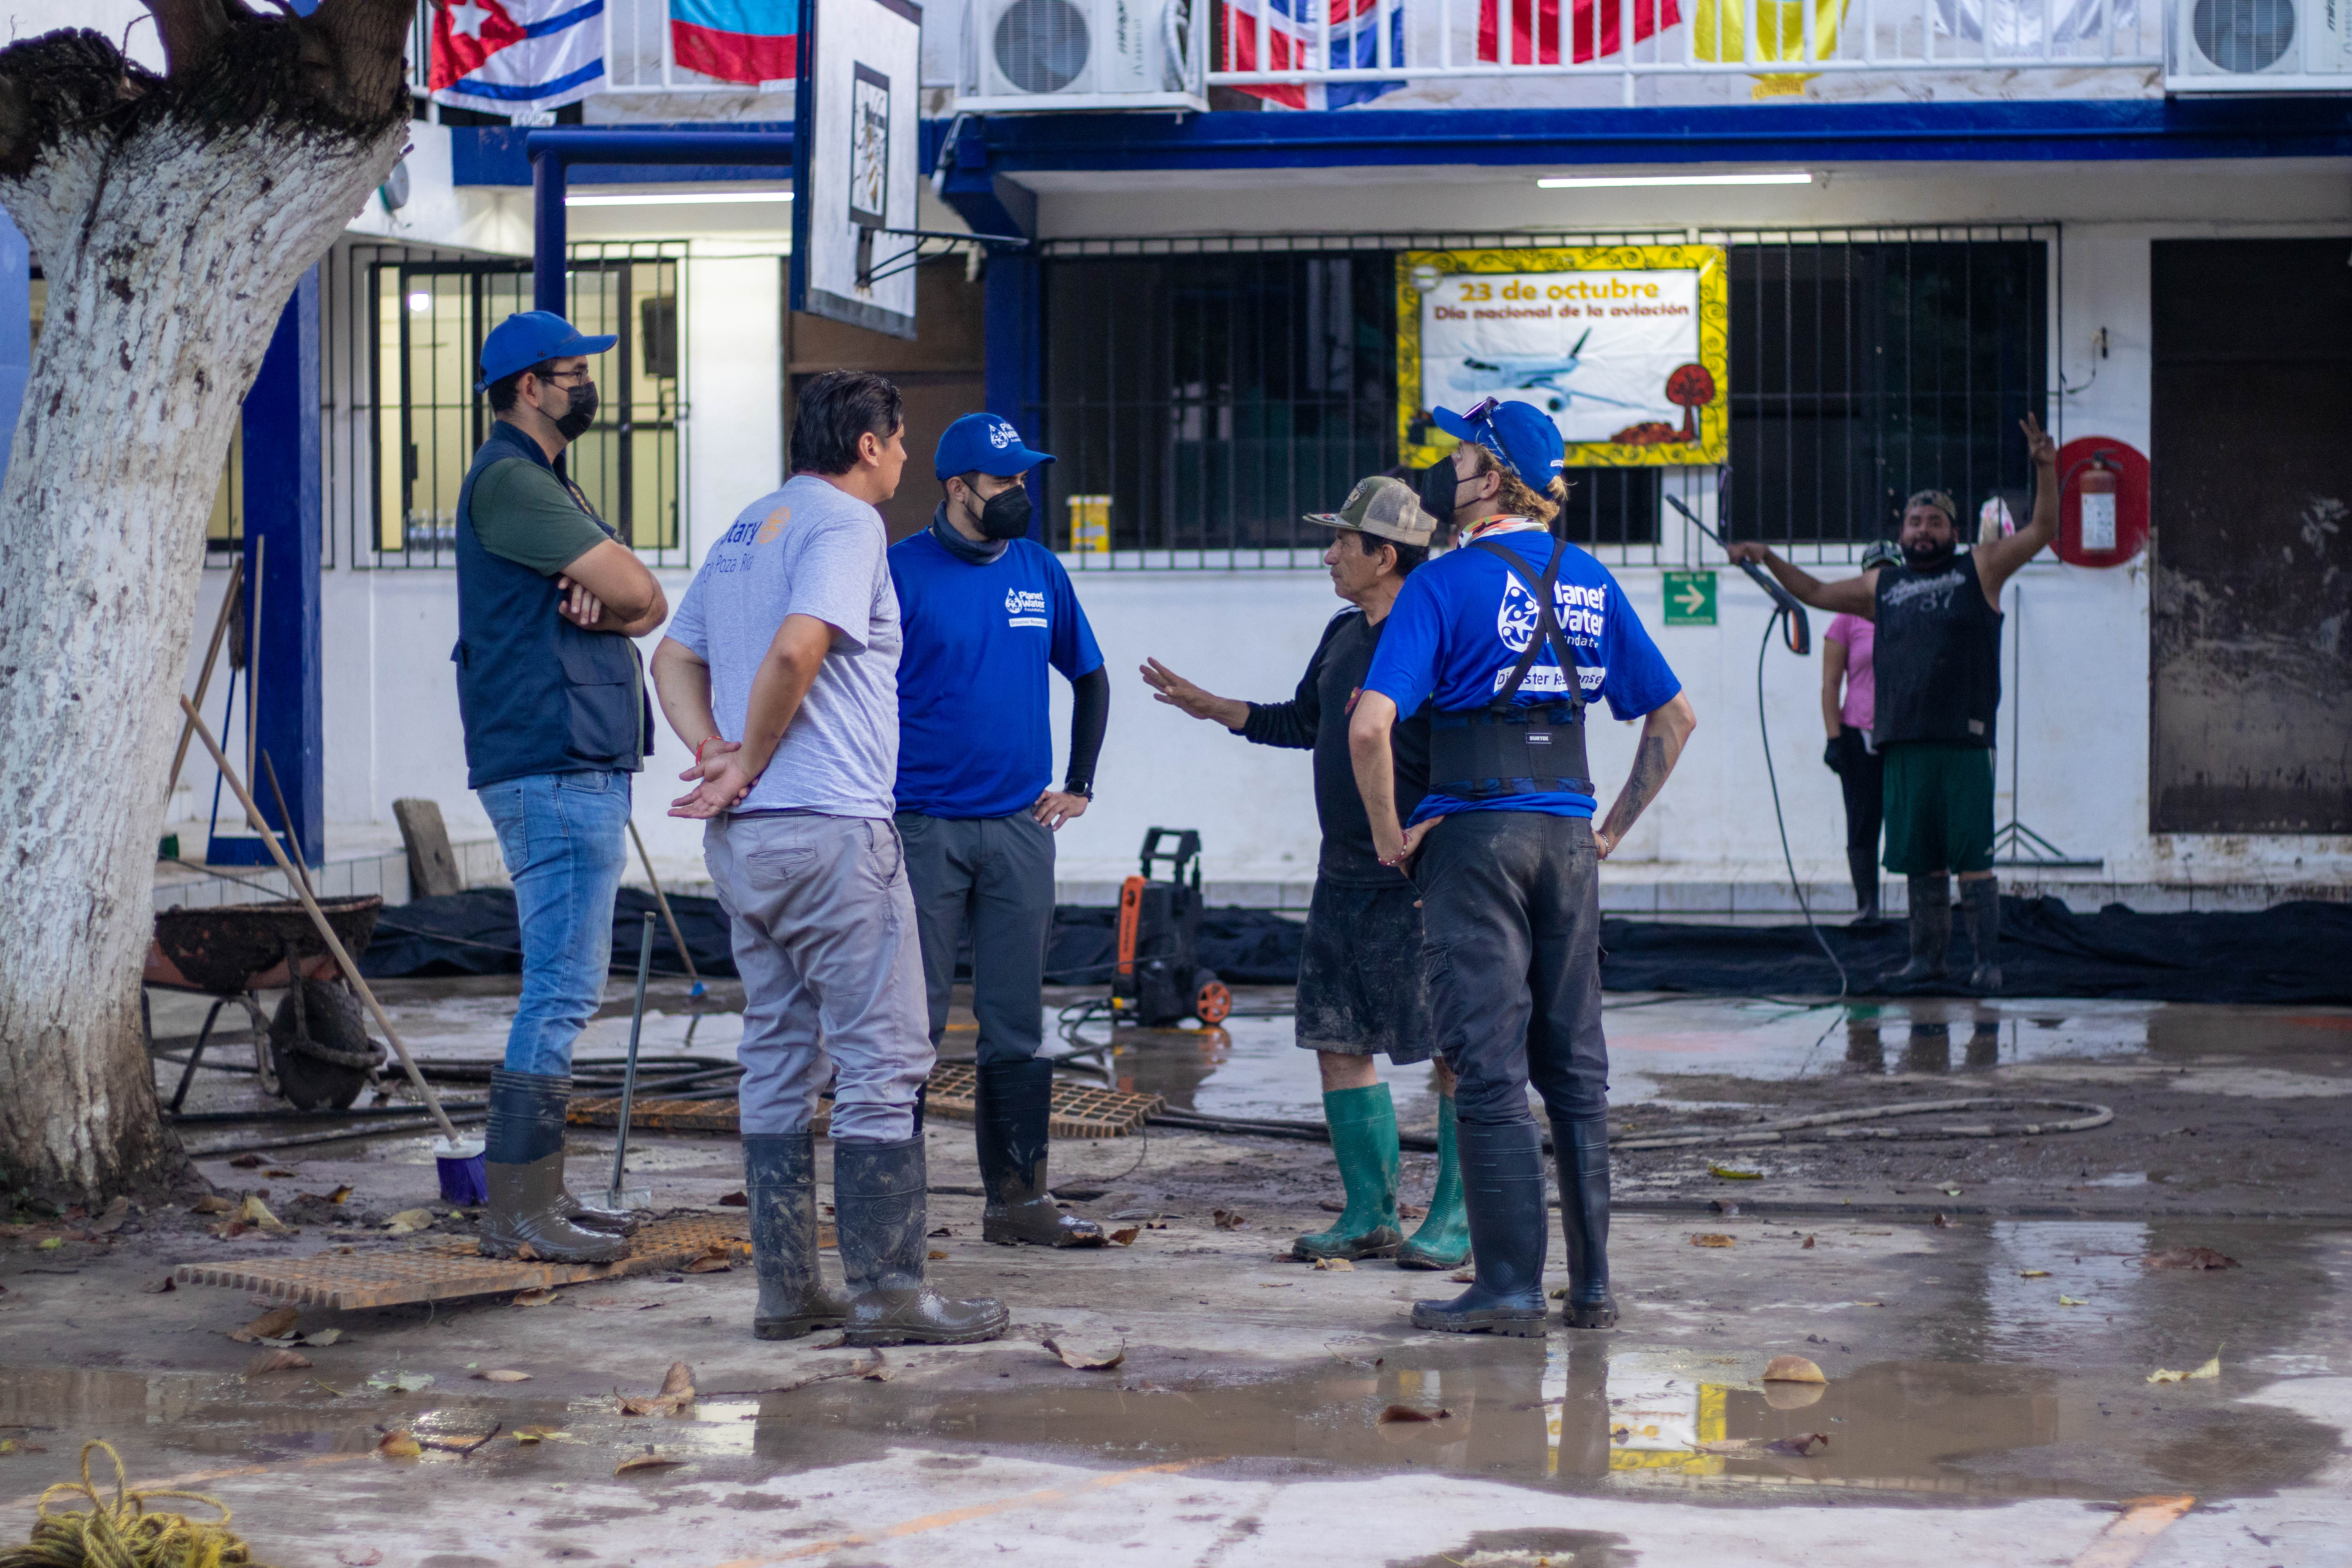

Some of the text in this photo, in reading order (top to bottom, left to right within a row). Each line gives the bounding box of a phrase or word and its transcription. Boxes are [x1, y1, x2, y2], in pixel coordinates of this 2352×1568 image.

[1459, 282, 1492, 301] 23
[1501, 279, 1537, 301] de
[1547, 277, 1659, 300] octubre
[1474, 304, 1552, 319] nacional
[1559, 305, 1580, 318] de
[1587, 304, 1603, 317] la
[1610, 301, 1688, 317] aviación
[715, 555, 737, 573] Poza
[1018, 591, 1044, 600] Planet
[1021, 599, 1045, 608] Water
[1554, 580, 1604, 612] lanet
[1497, 672, 1549, 685] Dister
